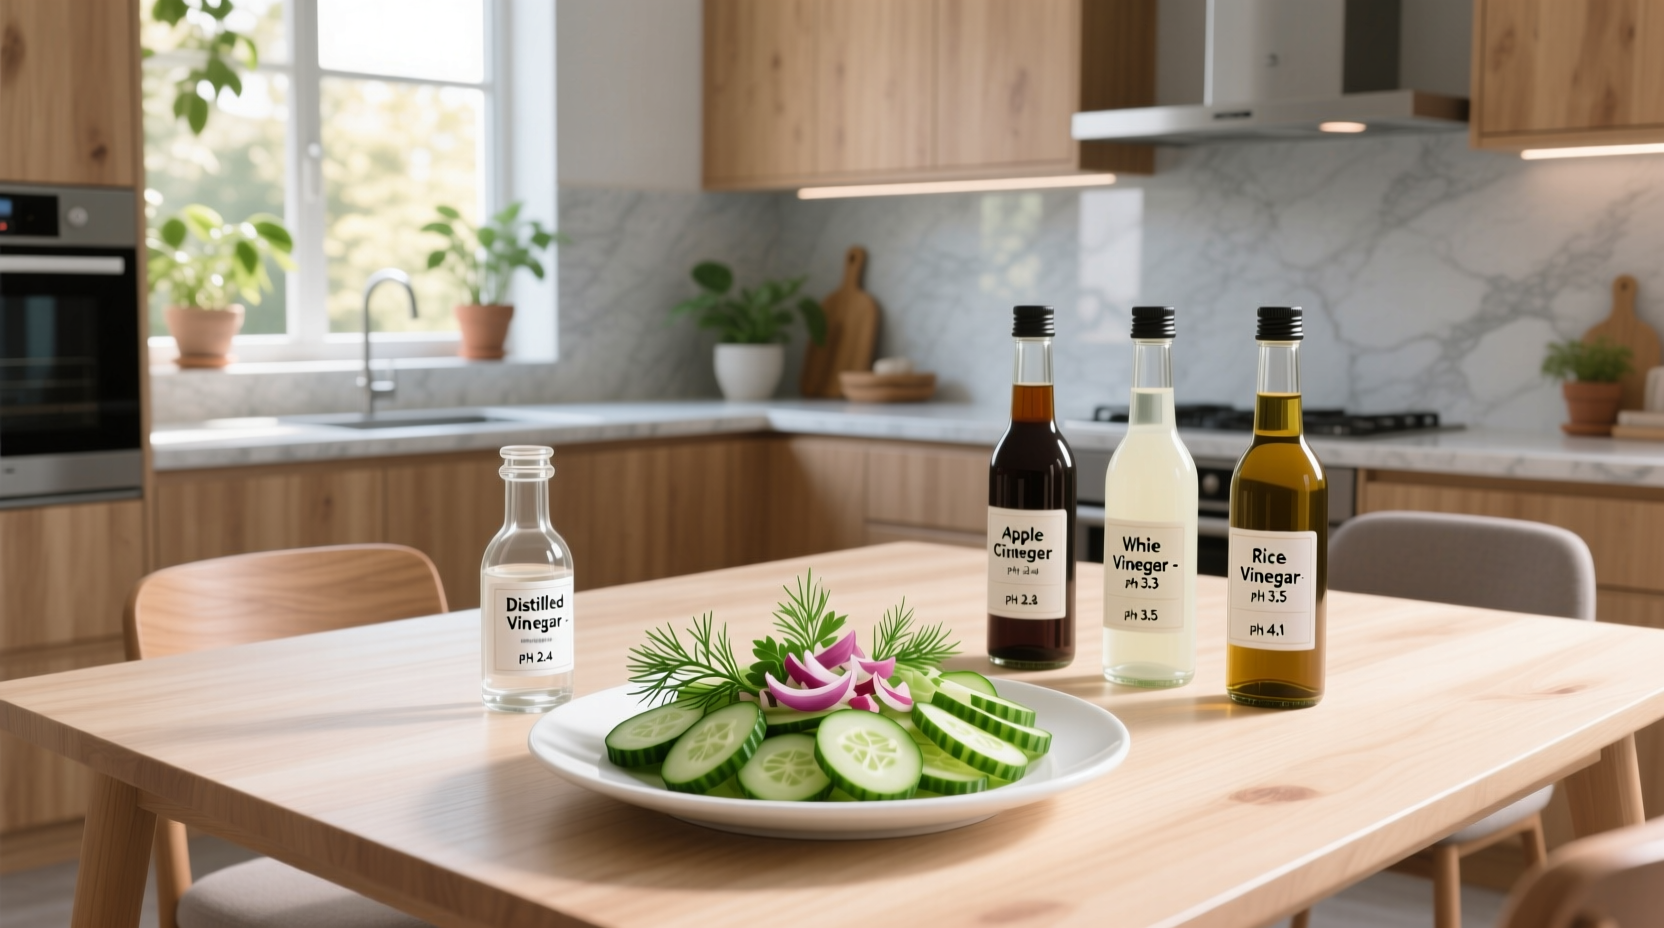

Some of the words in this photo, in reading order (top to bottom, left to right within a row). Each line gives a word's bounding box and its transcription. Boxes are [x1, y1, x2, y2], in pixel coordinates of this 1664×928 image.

[1002, 526, 1044, 545] Apple
[1122, 536, 1161, 553] Whie
[1252, 548, 1287, 564] Rice
[1140, 577, 1159, 589] 3.3
[506, 594, 564, 612] Distilled
[1268, 590, 1287, 603] 3.5
[1140, 609, 1158, 621] 3.5
[506, 616, 562, 633] Vinegar
[1266, 624, 1284, 636] 4.1
[519, 652, 534, 664] pH
[537, 650, 553, 662] 2.4
